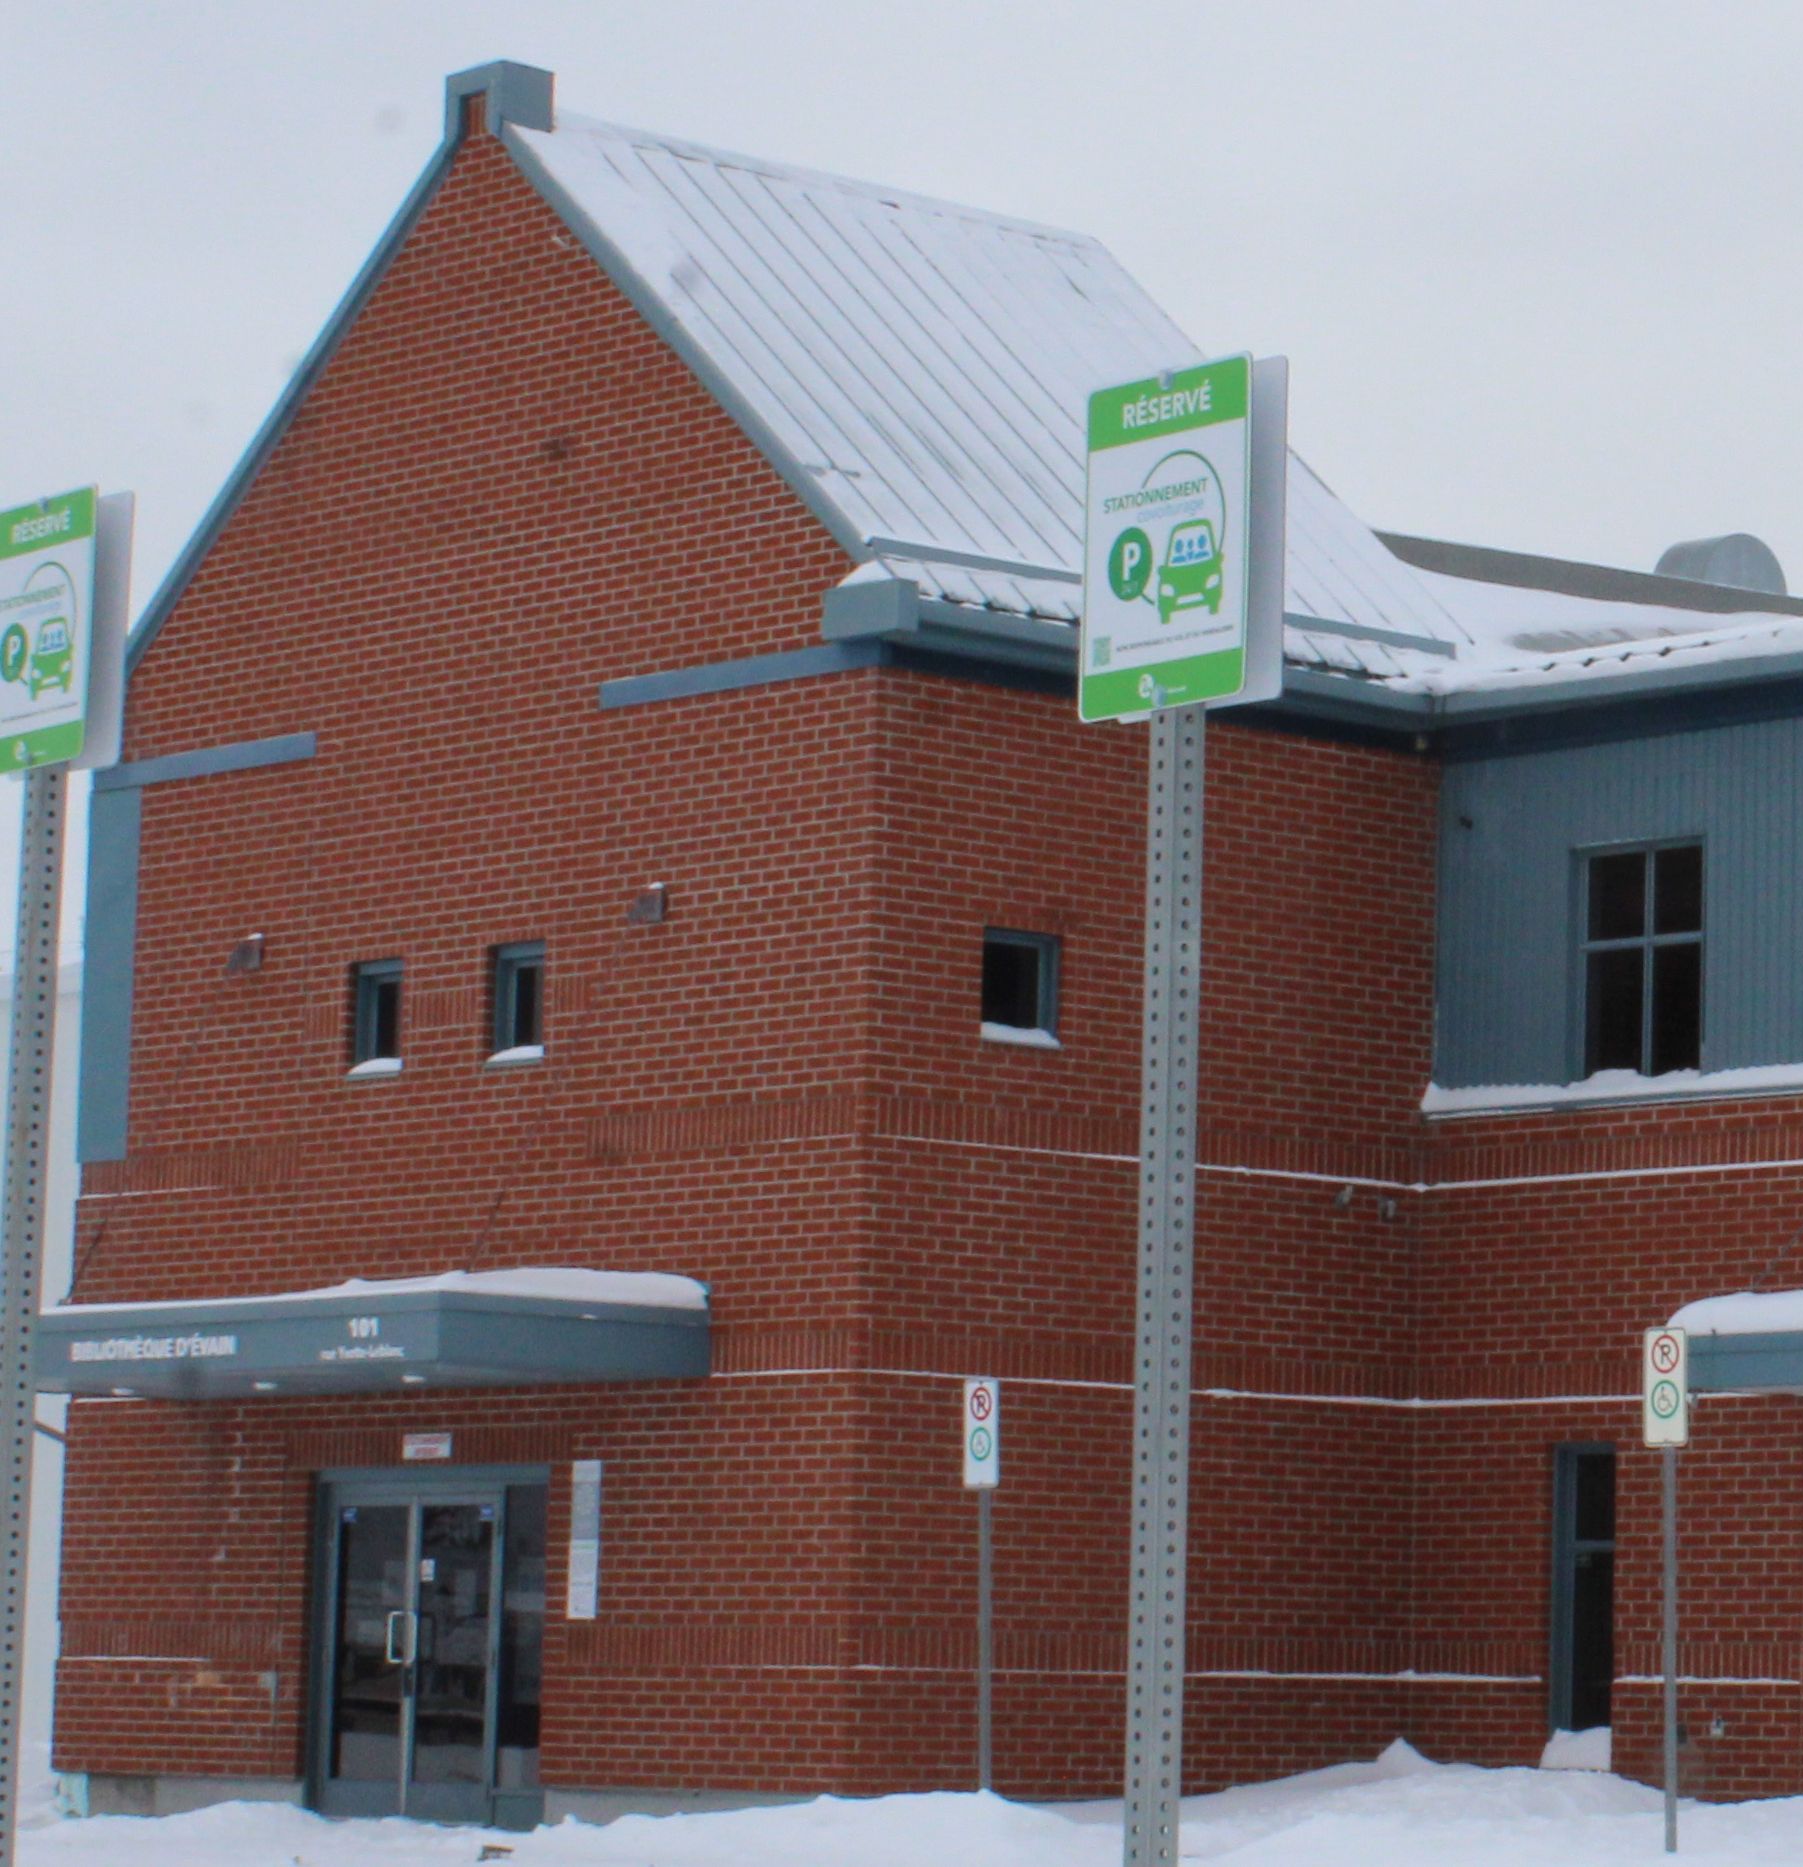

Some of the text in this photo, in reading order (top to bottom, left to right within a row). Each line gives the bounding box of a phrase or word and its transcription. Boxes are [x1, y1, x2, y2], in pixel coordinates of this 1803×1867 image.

[1122, 379, 1212, 430] RÉSERVÉ
[1103, 477, 1208, 514] STATIONNEMENT
[11, 506, 71, 544] RÉSERVÉ
[1123, 542, 1141, 581] P
[348, 1316, 380, 1338] 101
[71, 1332, 238, 1363] BIBLIOTHÈQUE D'ÉVAIN
